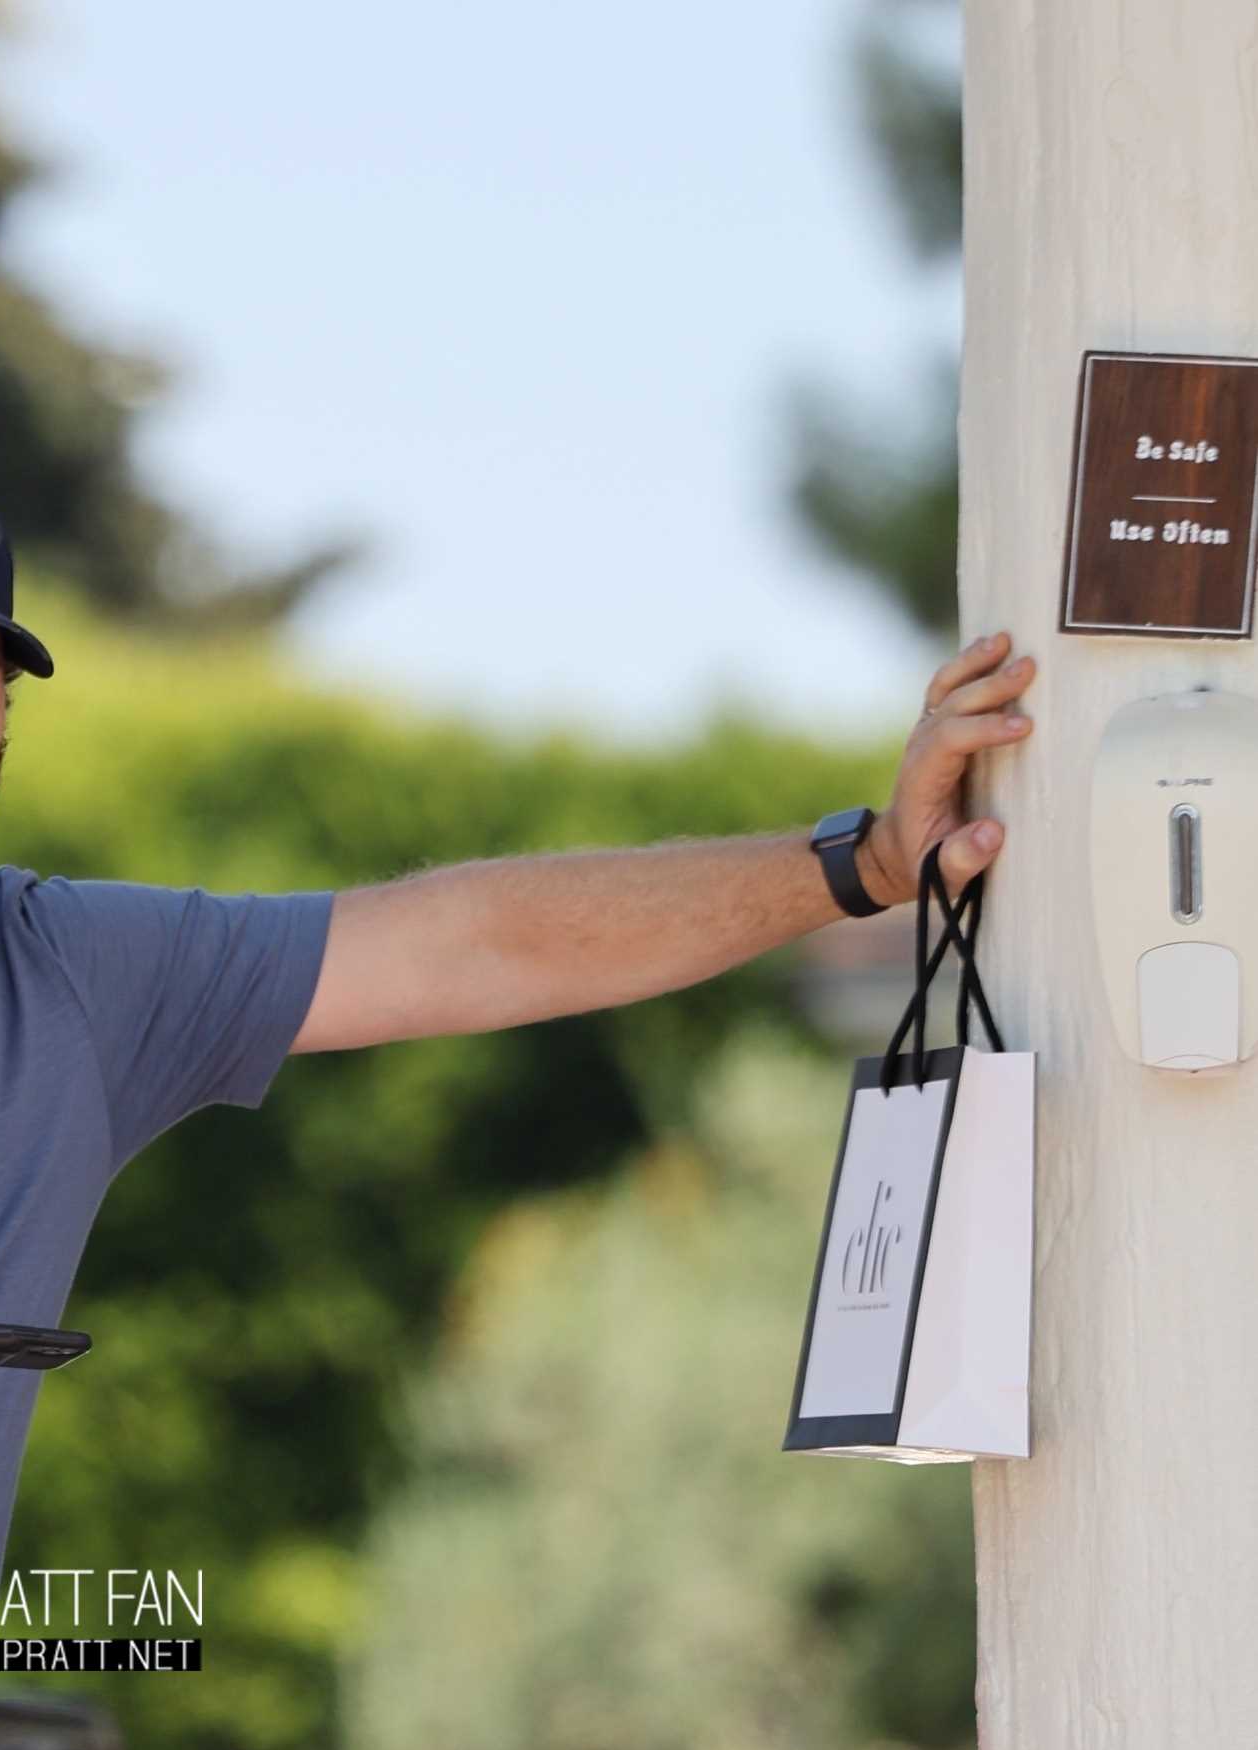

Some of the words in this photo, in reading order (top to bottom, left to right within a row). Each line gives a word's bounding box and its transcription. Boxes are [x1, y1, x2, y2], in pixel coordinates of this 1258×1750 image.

[1135, 435, 1164, 460] Be
[1168, 440, 1219, 463] Safe
[1109, 519, 1154, 542] Use
[1162, 520, 1230, 545] Often
